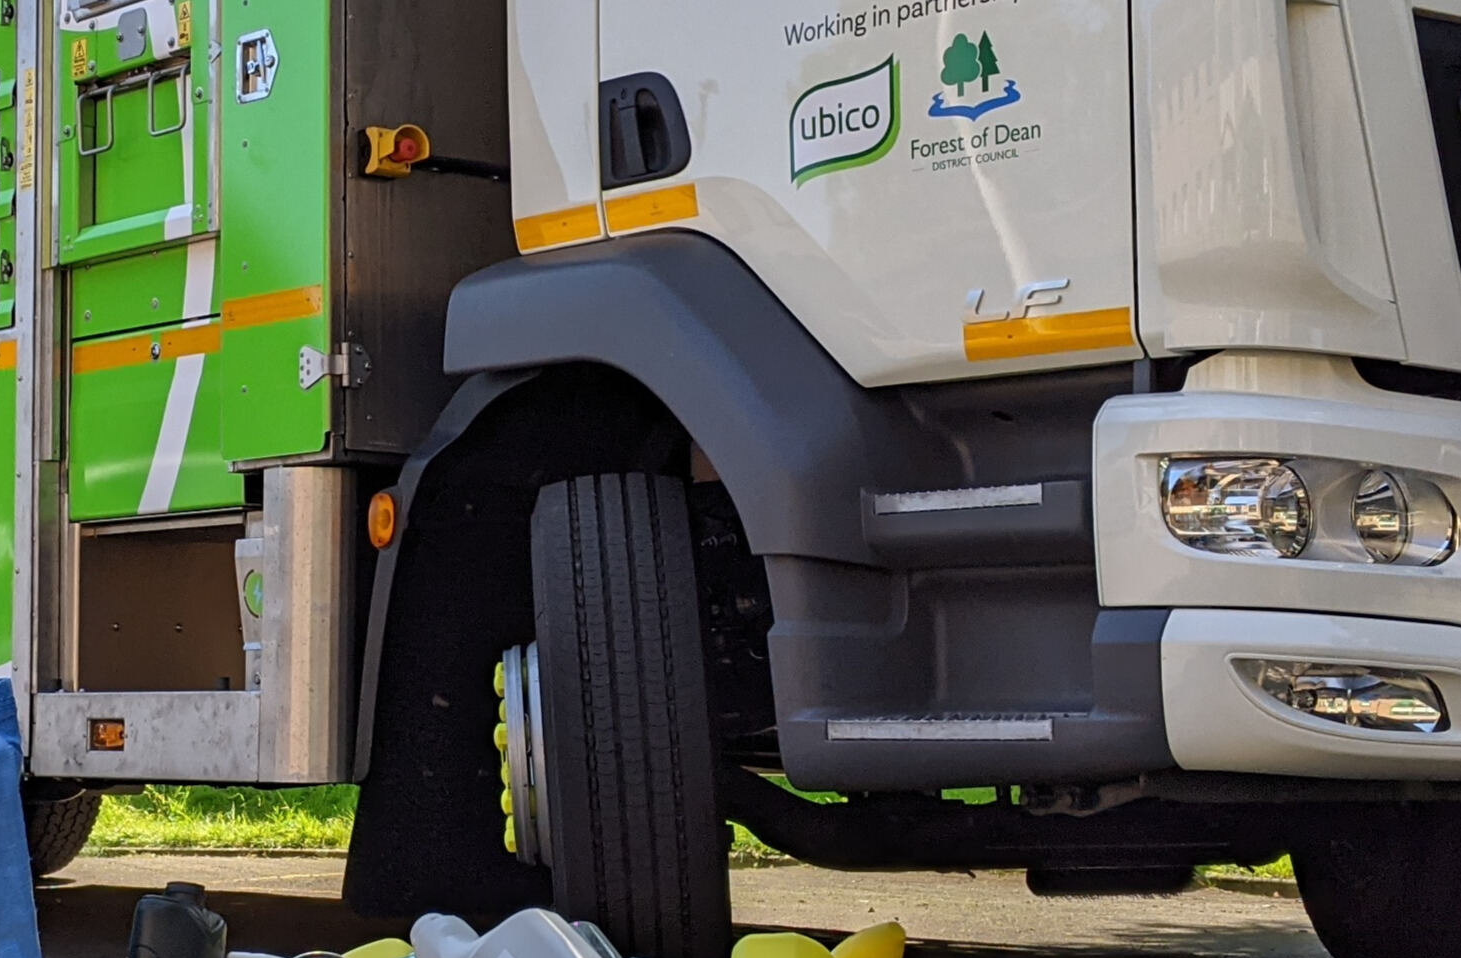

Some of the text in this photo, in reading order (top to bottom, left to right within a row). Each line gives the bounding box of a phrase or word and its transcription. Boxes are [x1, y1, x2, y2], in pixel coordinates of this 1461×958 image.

[784, 13, 867, 46] Working
[872, 5, 891, 27] in
[801, 102, 880, 140] ubico
[911, 124, 1041, 160] Forest of Dean
[932, 148, 1019, 172] DISTRICT COUNCIL
[962, 278, 1071, 326] LF
